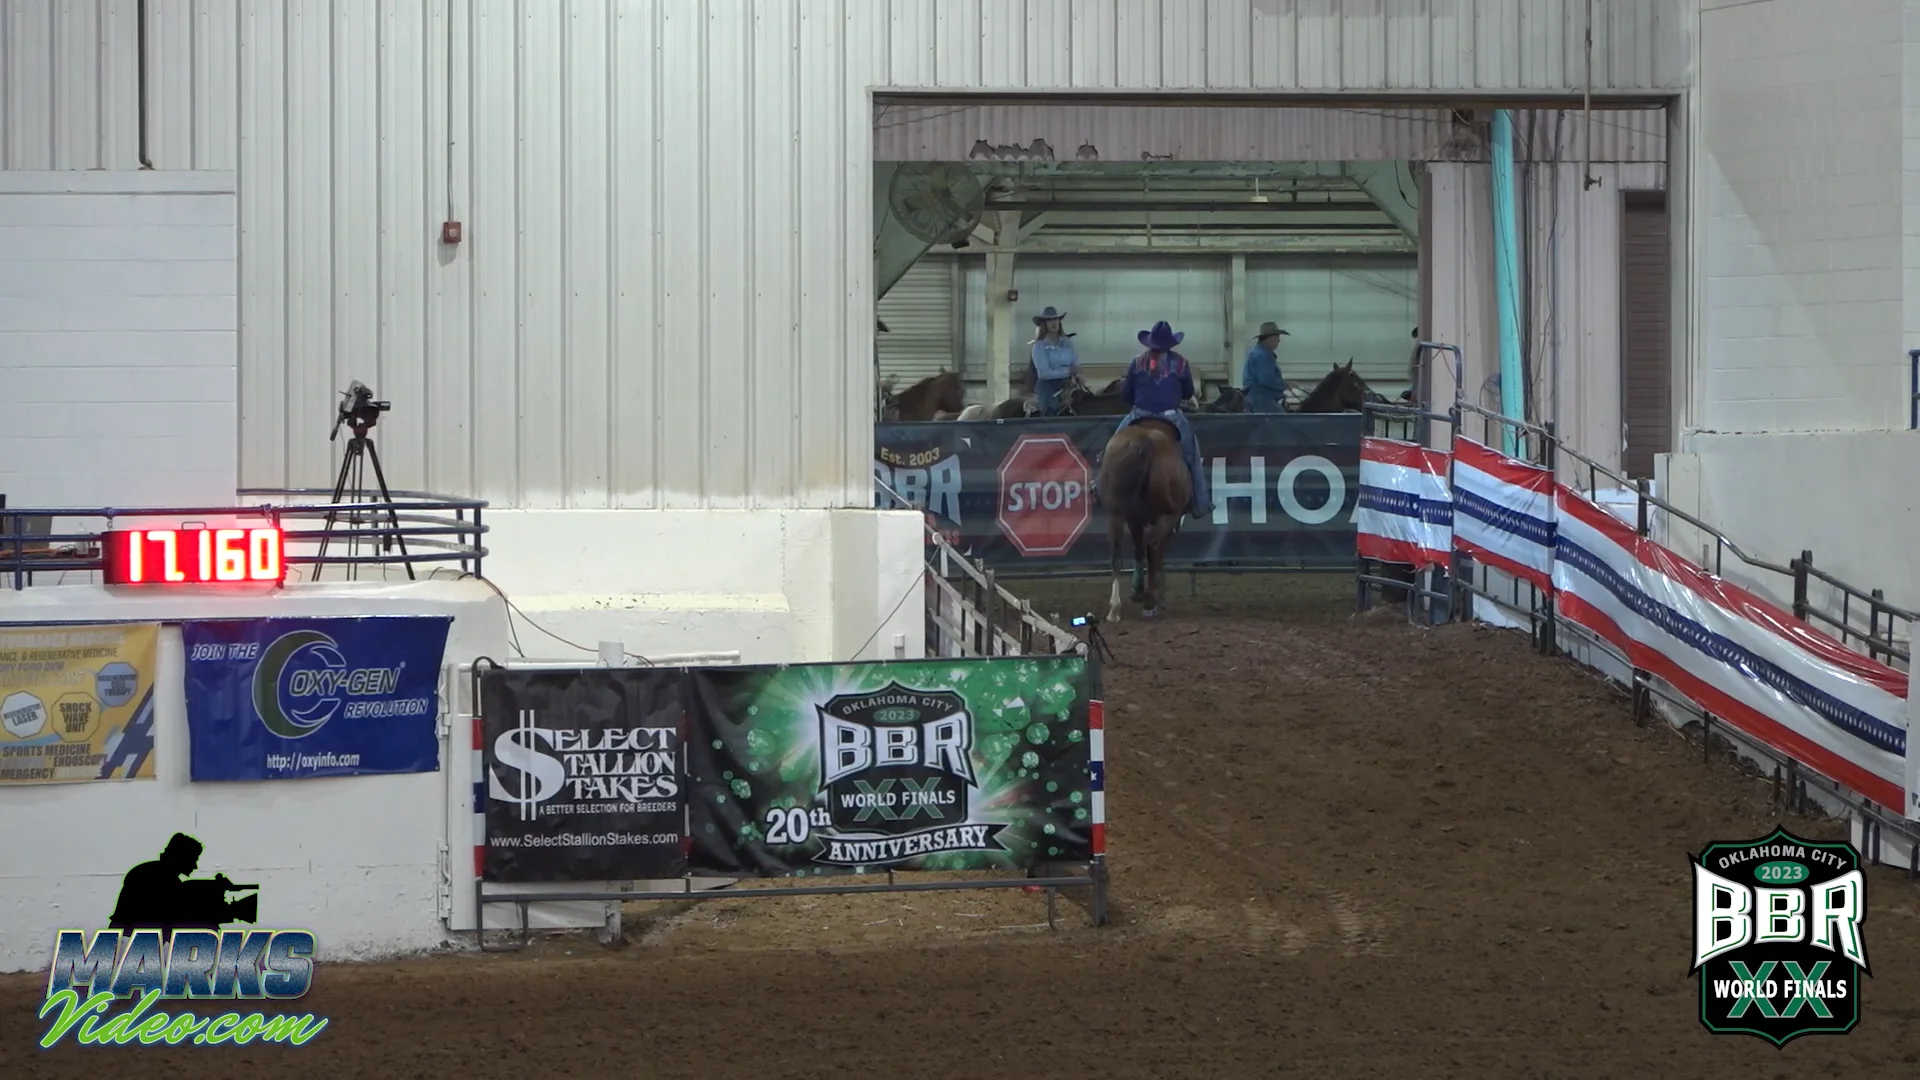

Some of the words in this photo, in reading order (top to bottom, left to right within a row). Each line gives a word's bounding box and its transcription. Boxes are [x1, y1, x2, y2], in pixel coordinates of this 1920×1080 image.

[881, 447, 905, 465] Est.
[909, 447, 940, 466] 2003
[1008, 481, 1081, 511] STOP
[1200, 455, 1359, 524] HO
[83, 648, 118, 658] MEDICINE
[191, 644, 226, 660] JOIN
[228, 643, 259, 659] THE
[104, 688, 131, 696] THERAPY
[59, 702, 92, 713] SHOCK
[344, 699, 428, 718] REVOLUTION
[842, 695, 917, 716] OKLAHOMA
[922, 697, 953, 713] CITY
[11, 711, 38, 727] LASER
[63, 713, 89, 723] WAVE
[879, 709, 915, 721] 2023
[65, 722, 85, 733] UNIT
[3, 745, 42, 757] SPORTS
[44, 743, 91, 756] MEDICINE
[823, 711, 976, 785] BBR
[267, 752, 360, 771] http://oxyinfo.com
[841, 792, 896, 808] WORLD
[902, 790, 956, 806] FINALS
[539, 806, 545, 815] A
[546, 804, 574, 815] BETTER
[576, 803, 617, 814] SELECTION
[620, 803, 634, 813] FOR
[637, 802, 677, 812] BREEDERS
[765, 807, 831, 844] 20th
[490, 832, 678, 848] www.SelectStallionStakes.com
[828, 825, 989, 861] ANNIVERSARY
